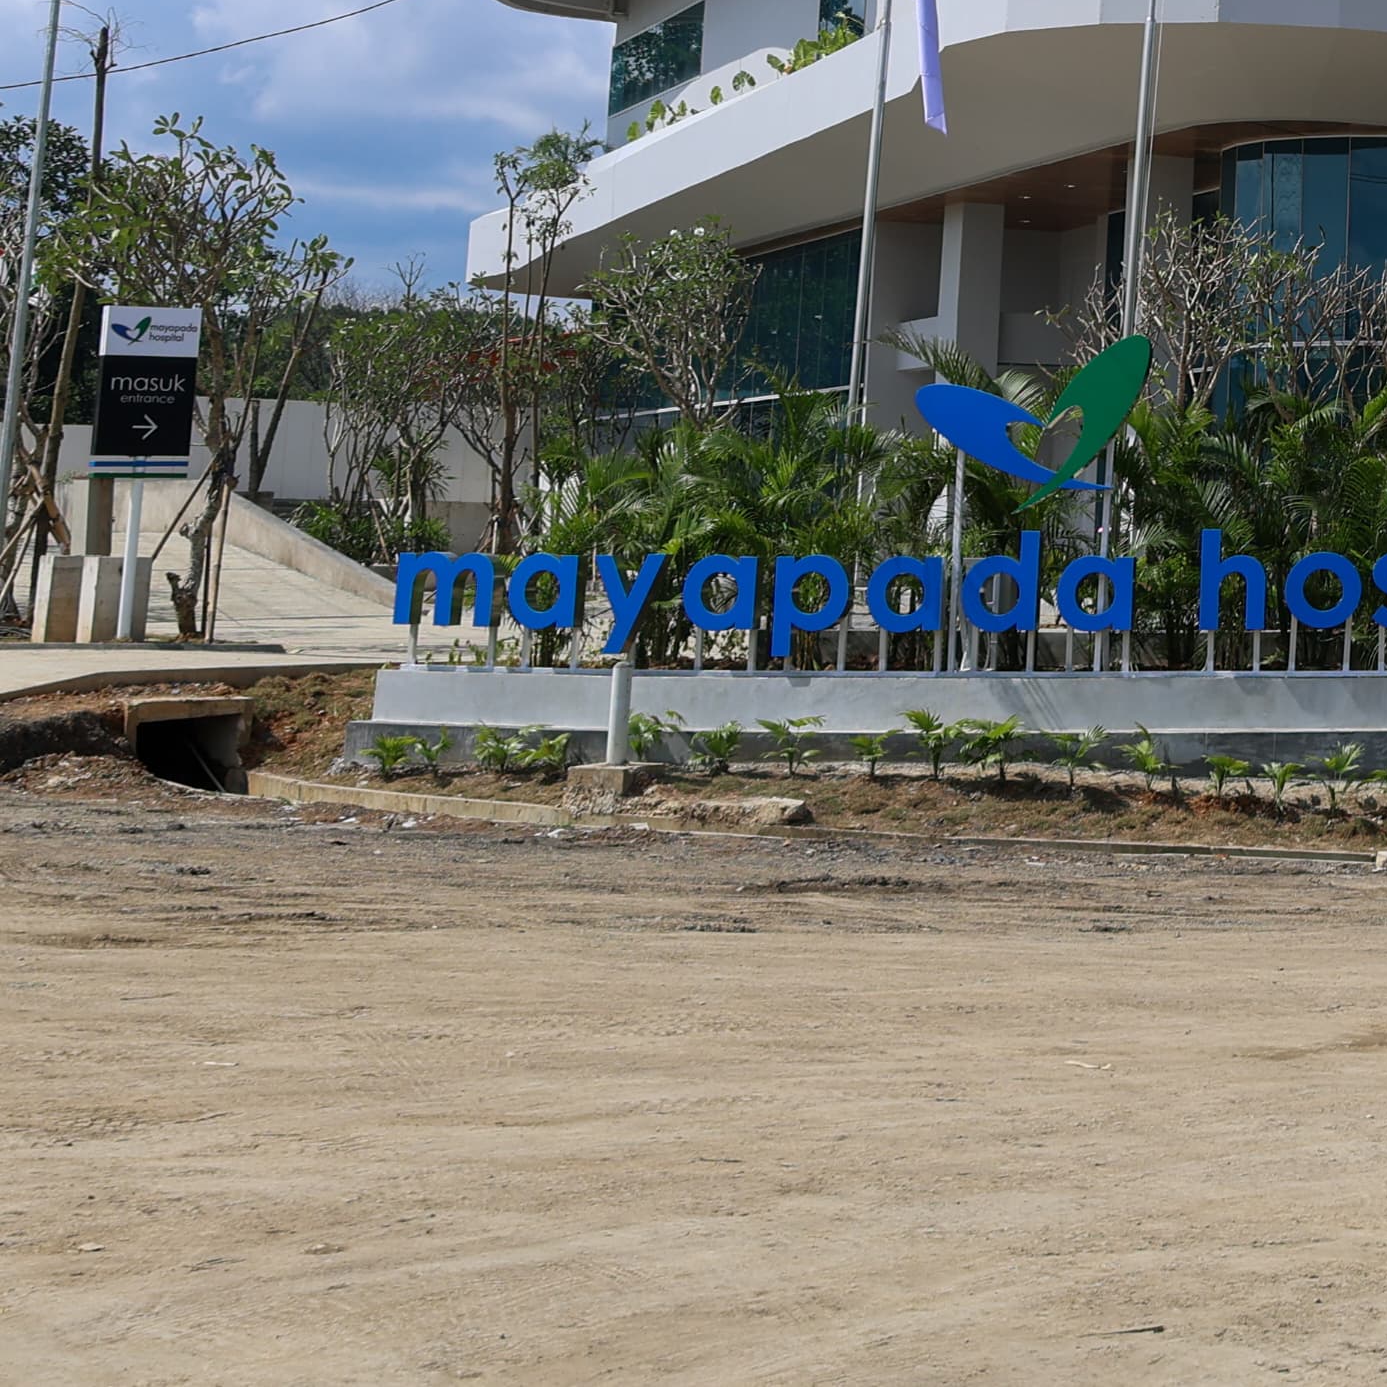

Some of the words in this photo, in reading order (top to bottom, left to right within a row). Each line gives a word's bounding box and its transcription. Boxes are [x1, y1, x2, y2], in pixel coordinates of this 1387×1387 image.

[150, 324, 198, 333] mayapada
[149, 332, 184, 343] hospital
[111, 374, 186, 392] masuk
[120, 394, 175, 404] entrance
[393, 530, 1135, 657] mayapada
